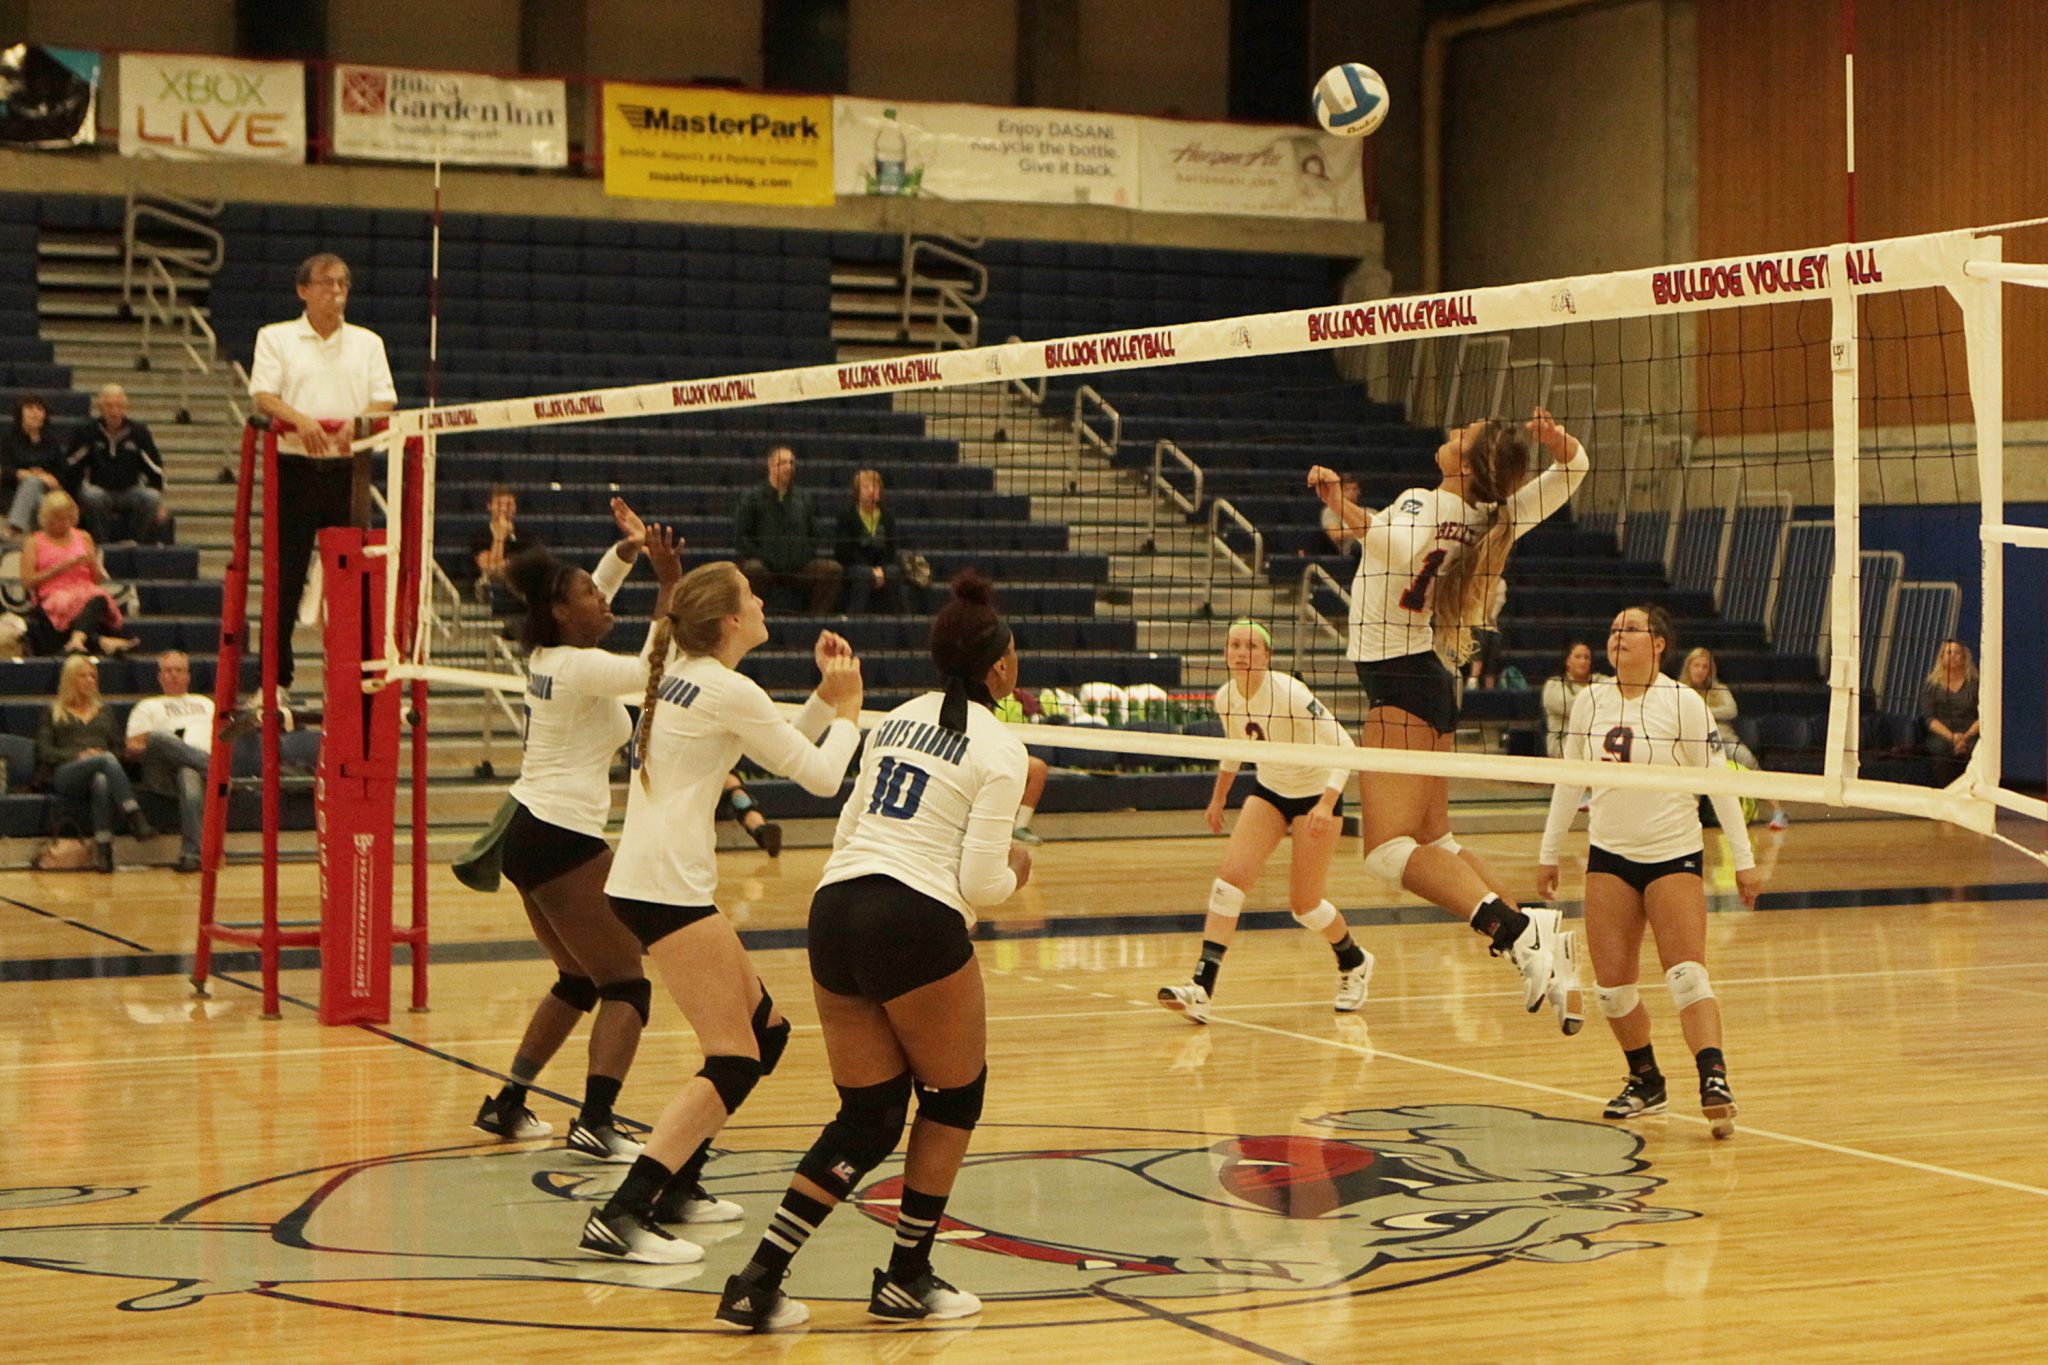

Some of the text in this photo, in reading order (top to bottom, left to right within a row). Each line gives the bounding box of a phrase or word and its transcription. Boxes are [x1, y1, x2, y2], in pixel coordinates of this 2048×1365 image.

[159, 69, 267, 107] XBOX
[136, 104, 288, 147] LIVE
[389, 95, 555, 126] Garden Inn
[643, 107, 819, 139] MasterPark
[998, 119, 1044, 138] Enjoy
[1018, 157, 1055, 173] Give
[1060, 160, 1070, 174] it
[1039, 141, 1066, 155] the
[1652, 248, 1882, 305] BULLDOG VOLLEYALL
[1308, 295, 1478, 343] BULLDOG VOLLEYBALL
[1045, 331, 1176, 369] BULLDOG VOLLEYBALL
[838, 358, 943, 390] BULLDOG VOLLEYBALL
[1399, 548, 1449, 613] 1
[1601, 726, 1634, 763] 9
[867, 756, 931, 820] 10
